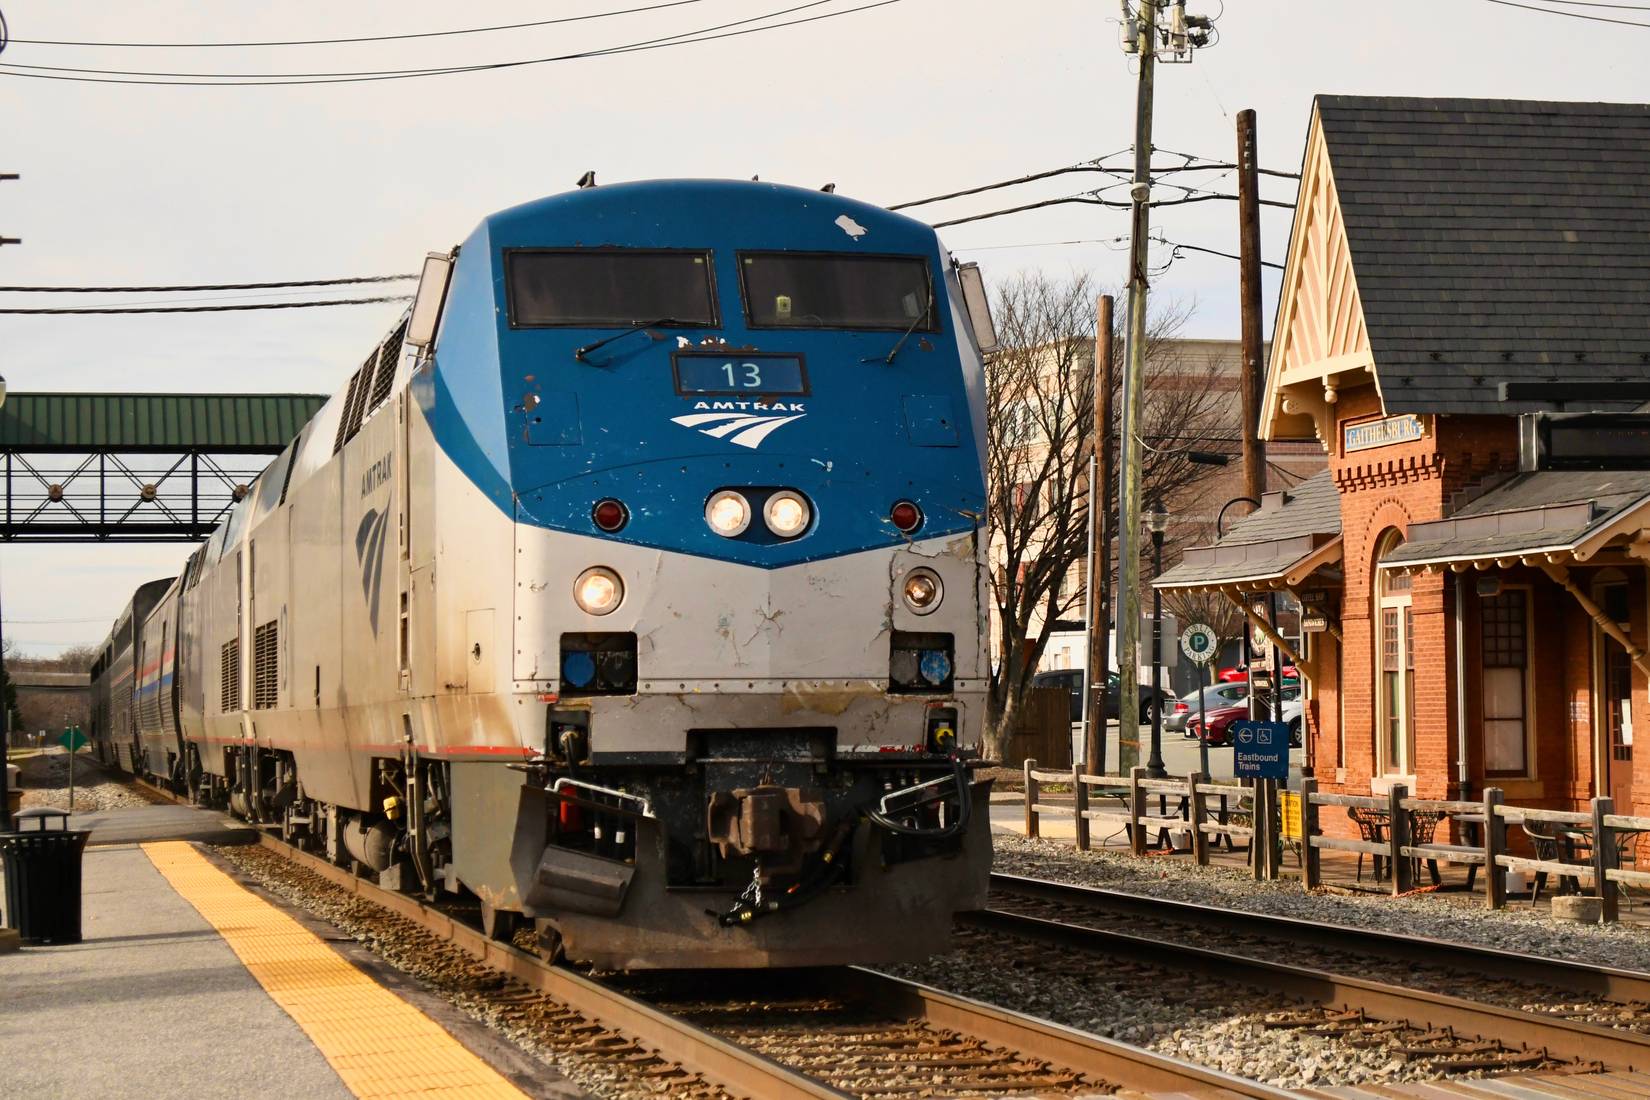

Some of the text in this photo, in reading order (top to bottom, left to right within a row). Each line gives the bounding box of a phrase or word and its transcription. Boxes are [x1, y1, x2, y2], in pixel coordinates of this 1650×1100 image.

[721, 363, 762, 387] 13
[694, 401, 806, 411] AMTRAK
[1348, 420, 1417, 446] GAITHERSBURG
[361, 451, 392, 500] AMTRAK
[1185, 624, 1213, 638] PUBLIC
[1194, 635, 1205, 650] P
[1184, 645, 1215, 661] PARKING
[1237, 752, 1279, 762] Eastbound
[1238, 761, 1261, 771] Trains
